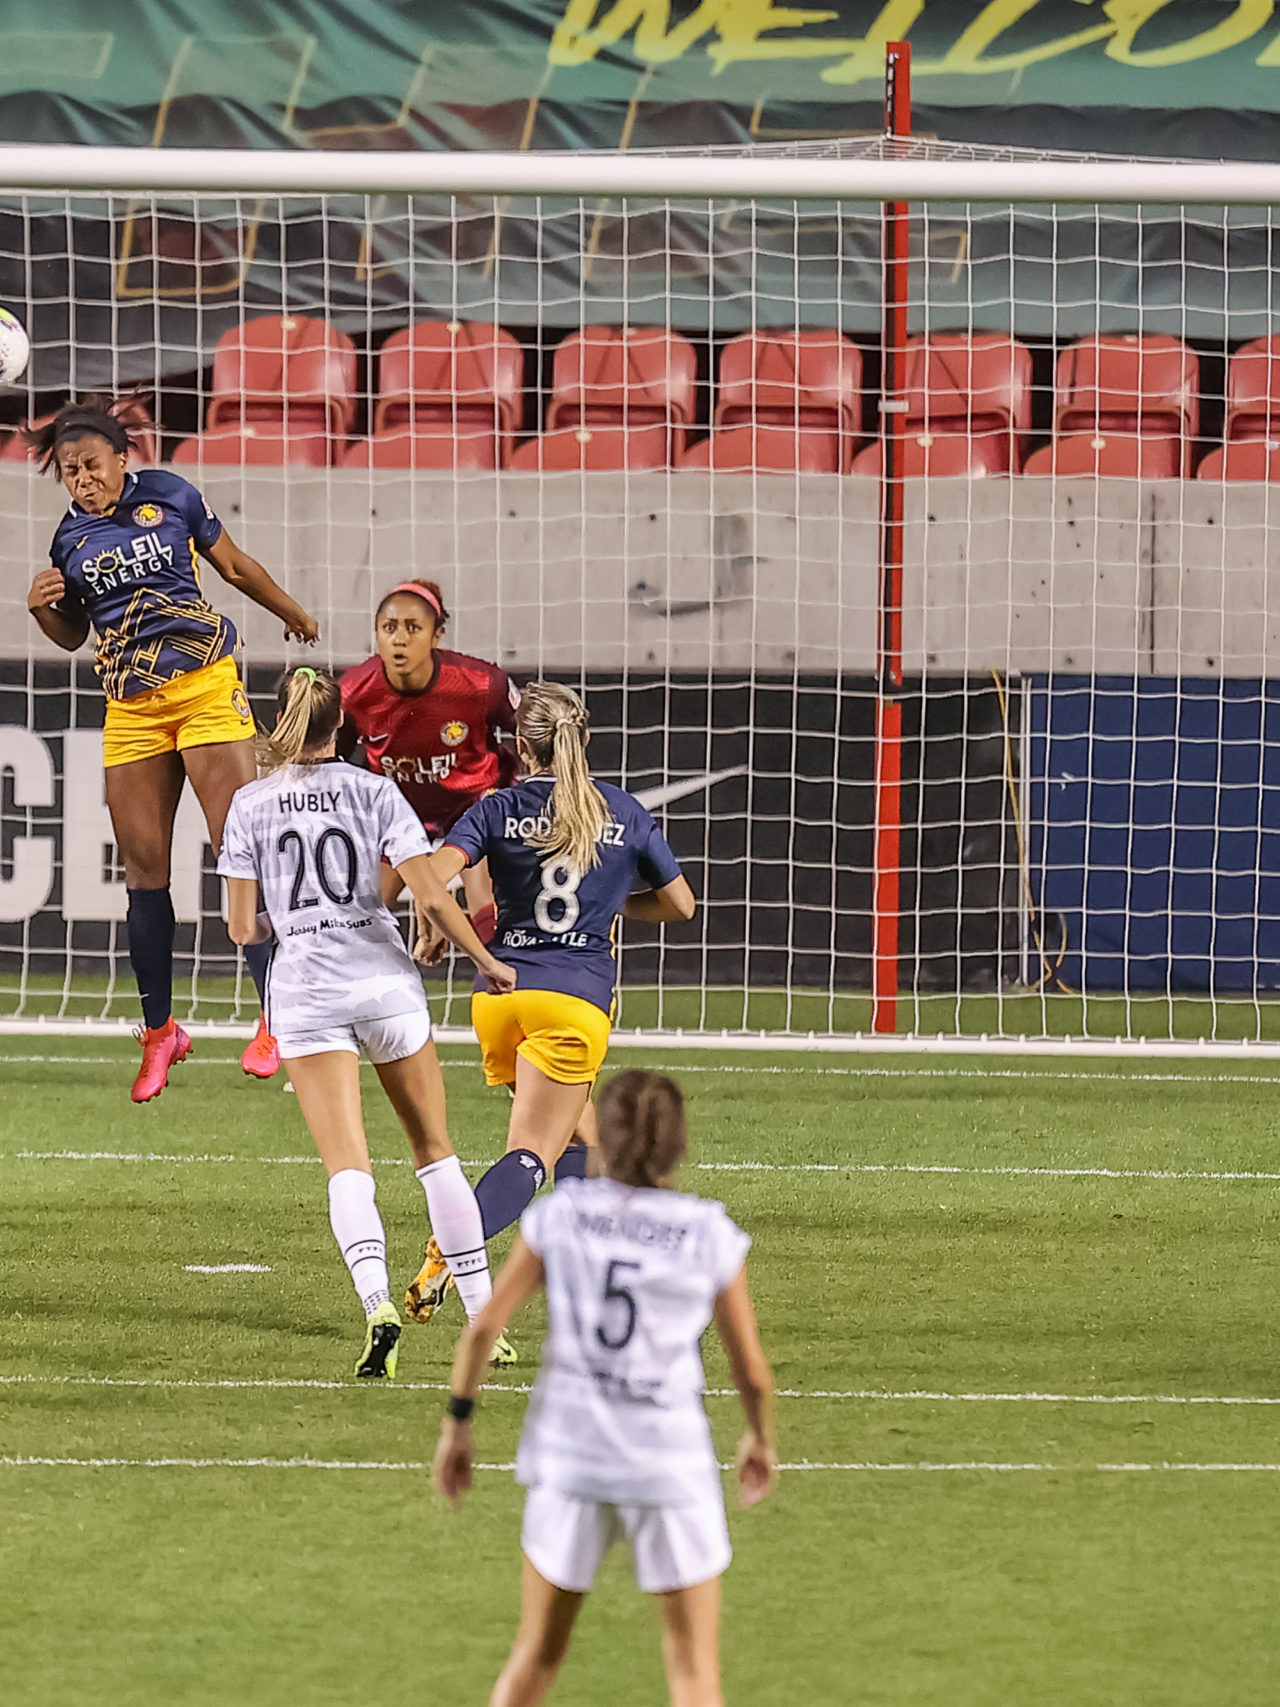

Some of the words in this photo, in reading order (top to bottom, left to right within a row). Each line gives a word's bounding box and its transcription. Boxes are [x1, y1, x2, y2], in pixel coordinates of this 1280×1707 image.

[548, 0, 1280, 84] WELCO
[81, 532, 173, 583] SOLEIL
[92, 550, 174, 596] ENERGY
[278, 790, 342, 814] HUBLY
[277, 827, 358, 912] 20
[534, 855, 580, 934] 8
[457, 1257, 483, 1269] PTFC
[596, 1256, 641, 1350] 5
